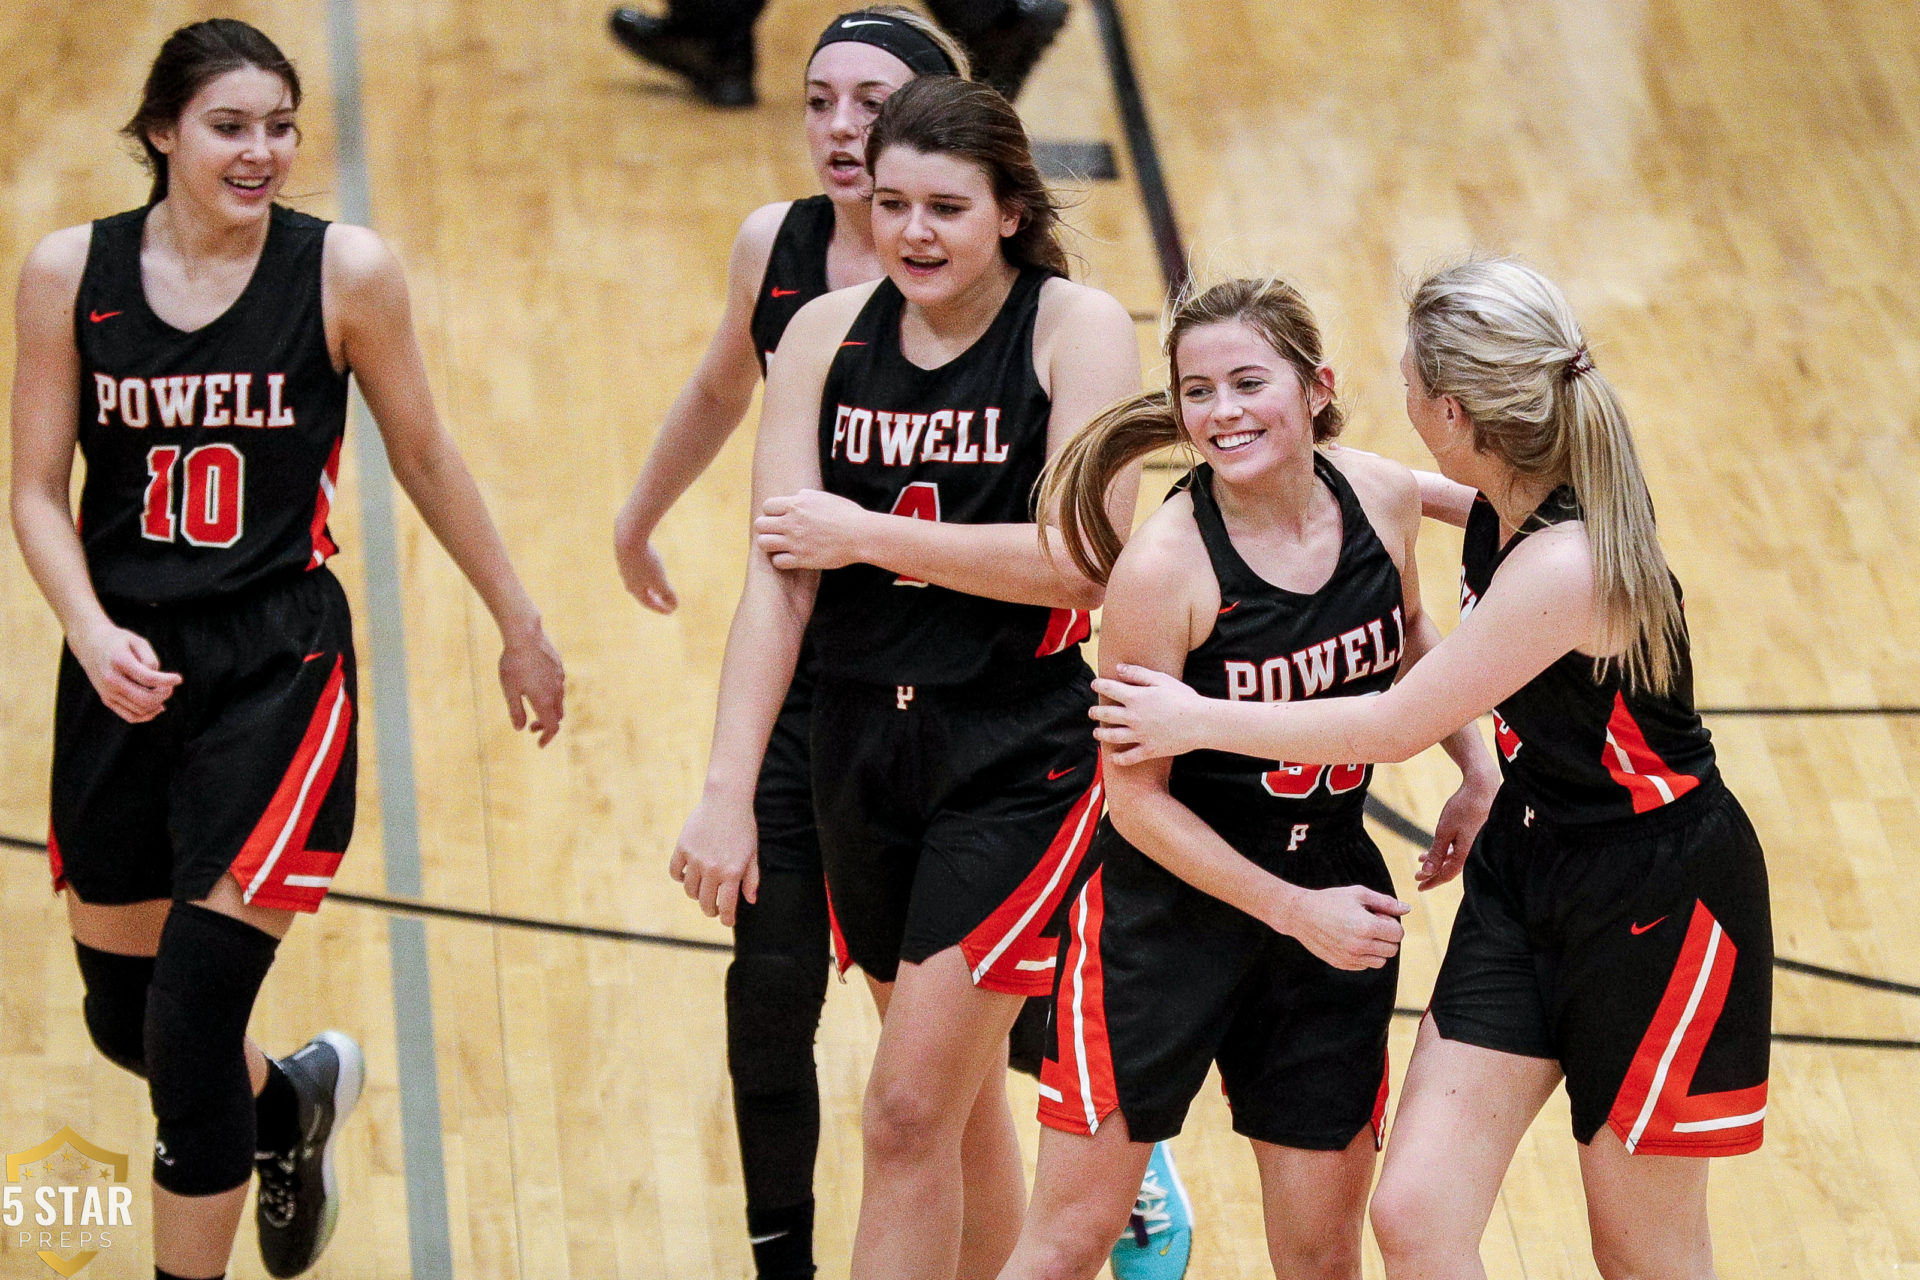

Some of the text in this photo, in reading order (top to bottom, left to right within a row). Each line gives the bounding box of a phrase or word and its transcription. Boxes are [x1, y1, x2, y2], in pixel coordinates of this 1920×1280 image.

[94, 373, 296, 428] POWELL
[831, 403, 1009, 466] POWELL
[140, 443, 244, 548] 10
[1287, 824, 1309, 851] P
